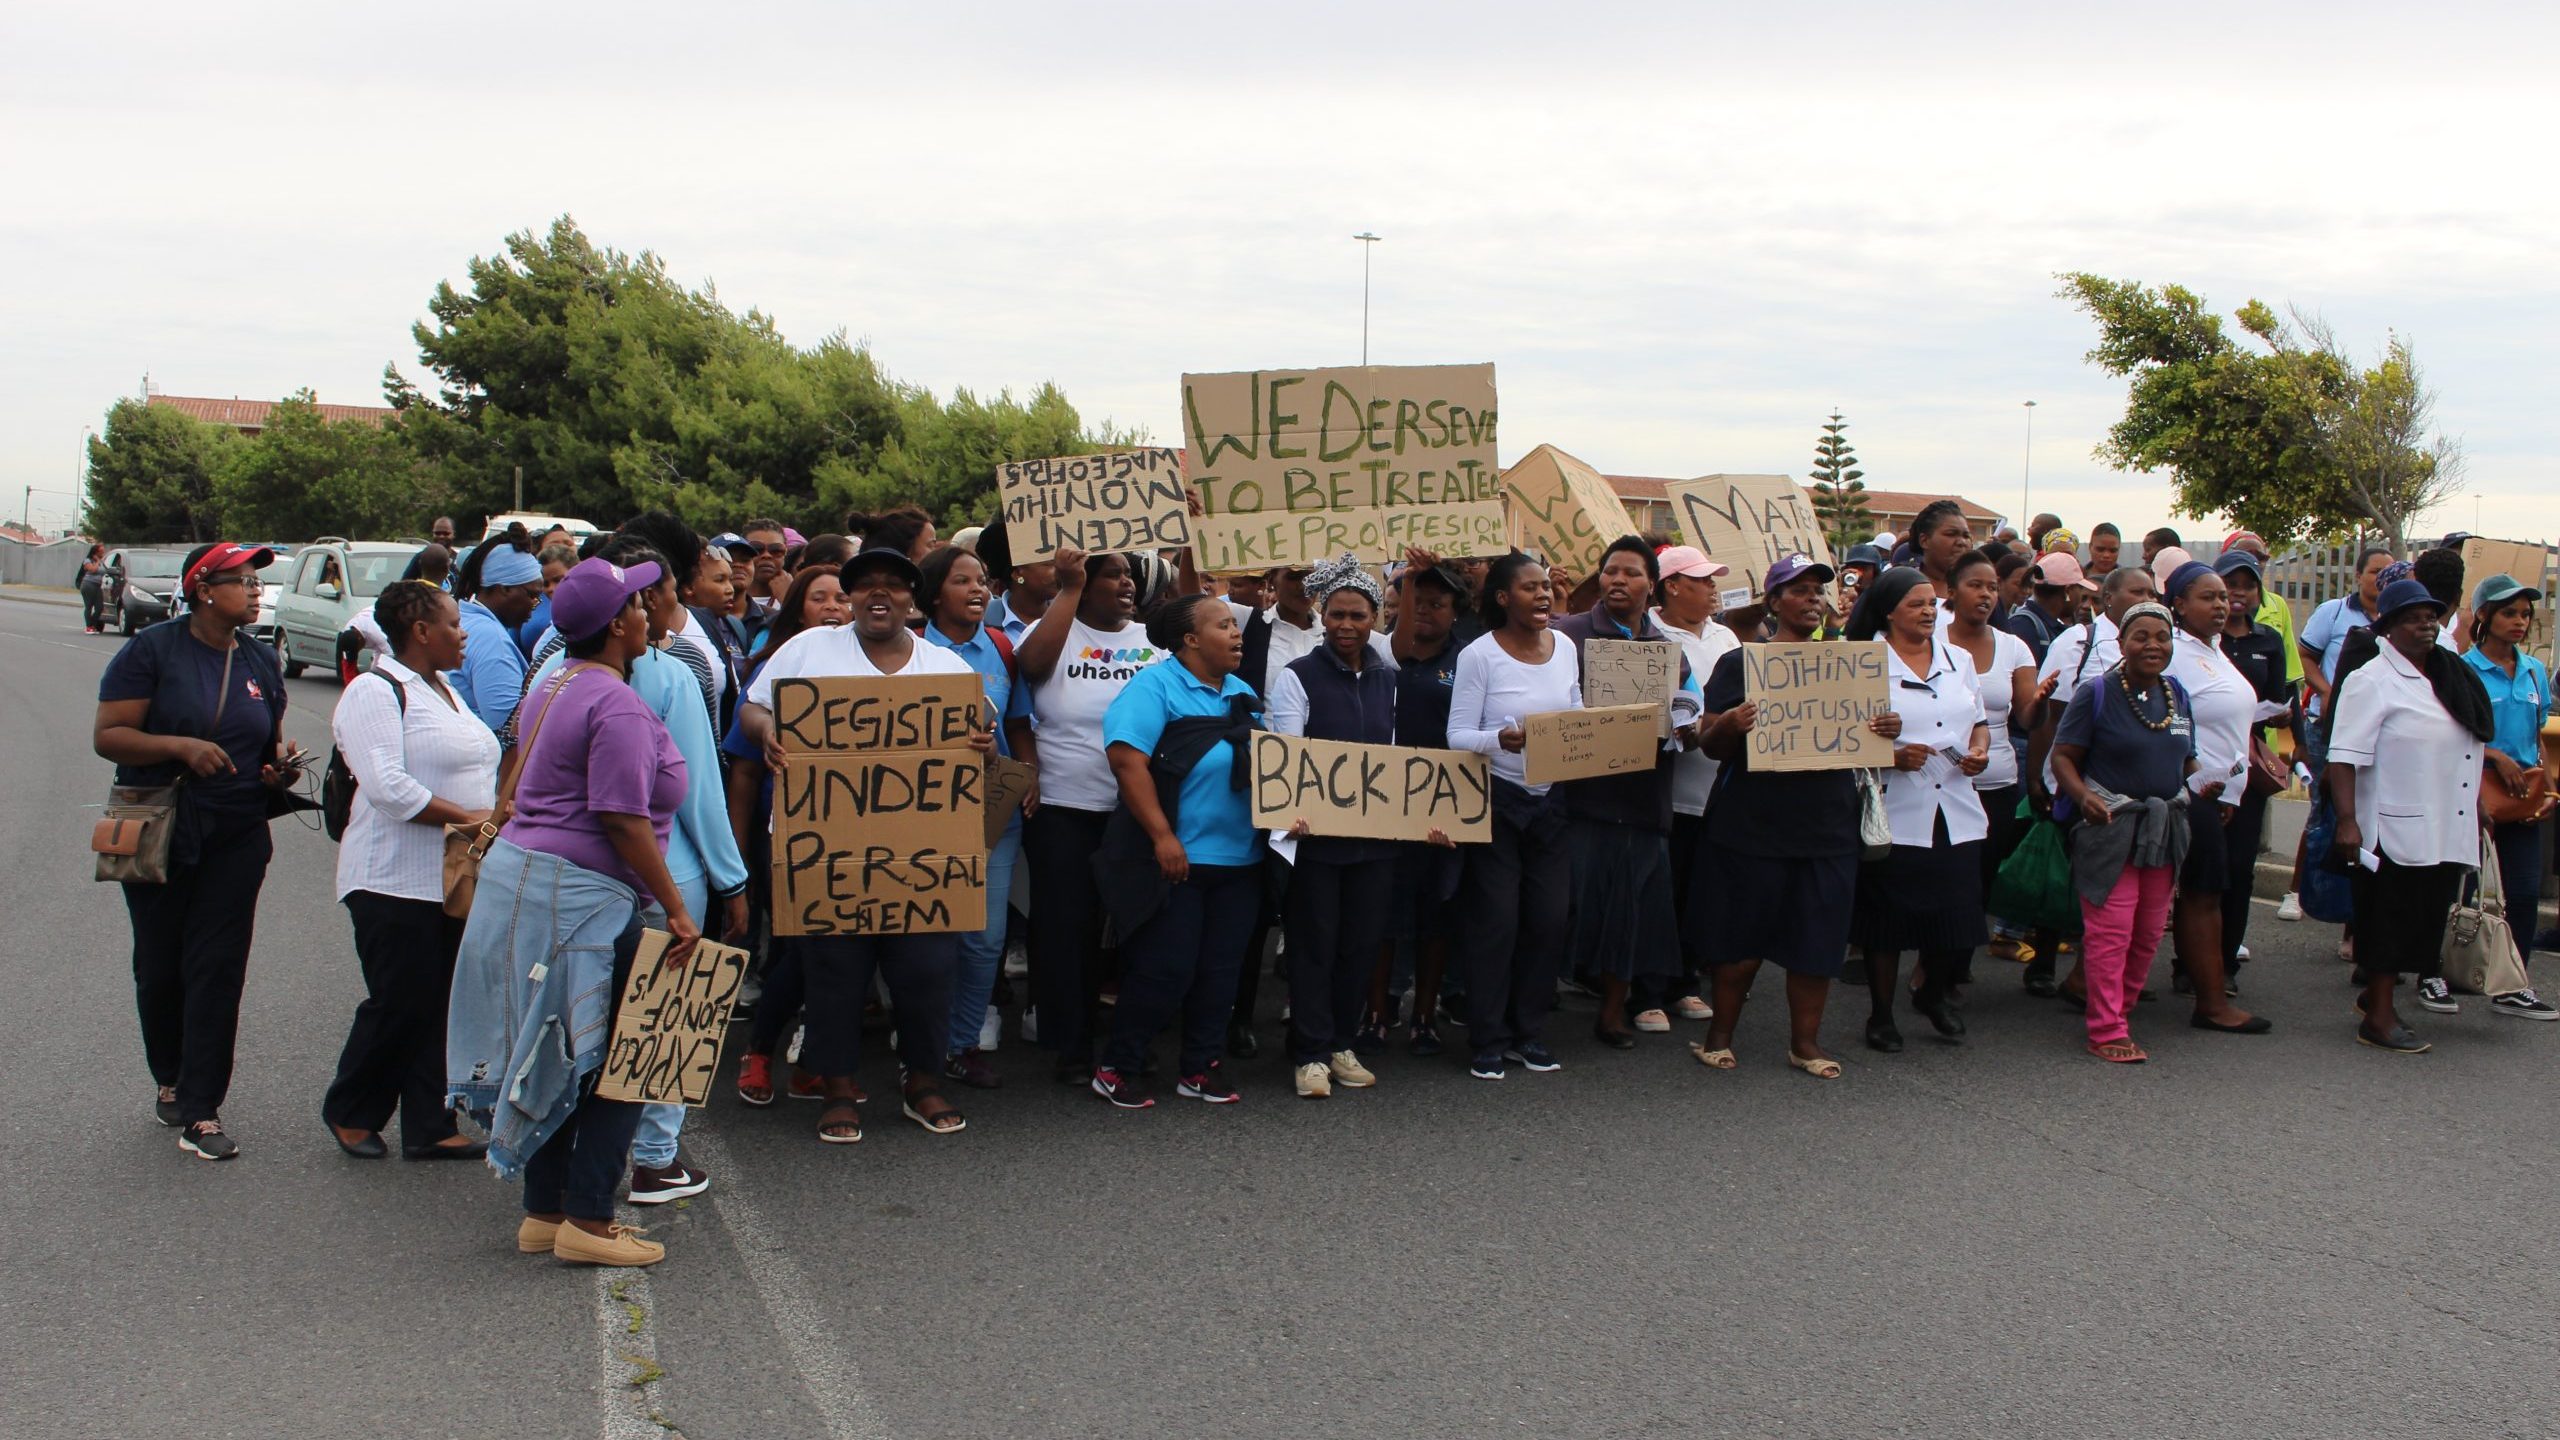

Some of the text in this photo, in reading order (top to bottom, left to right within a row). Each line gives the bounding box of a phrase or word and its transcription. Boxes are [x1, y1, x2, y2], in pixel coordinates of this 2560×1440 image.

[1187, 373, 1498, 468] WE DERSEVE
[1005, 469, 1186, 524] MONTHLY
[1192, 459, 1501, 520] TO BE TREATED
[1034, 508, 1190, 554] DECENT
[1756, 698, 1819, 728] BOUT
[1756, 725, 1861, 755] OUT US
[782, 758, 981, 822] UNDER
[1257, 734, 1490, 825] BACK PAY
[786, 831, 985, 903] PERSAL
